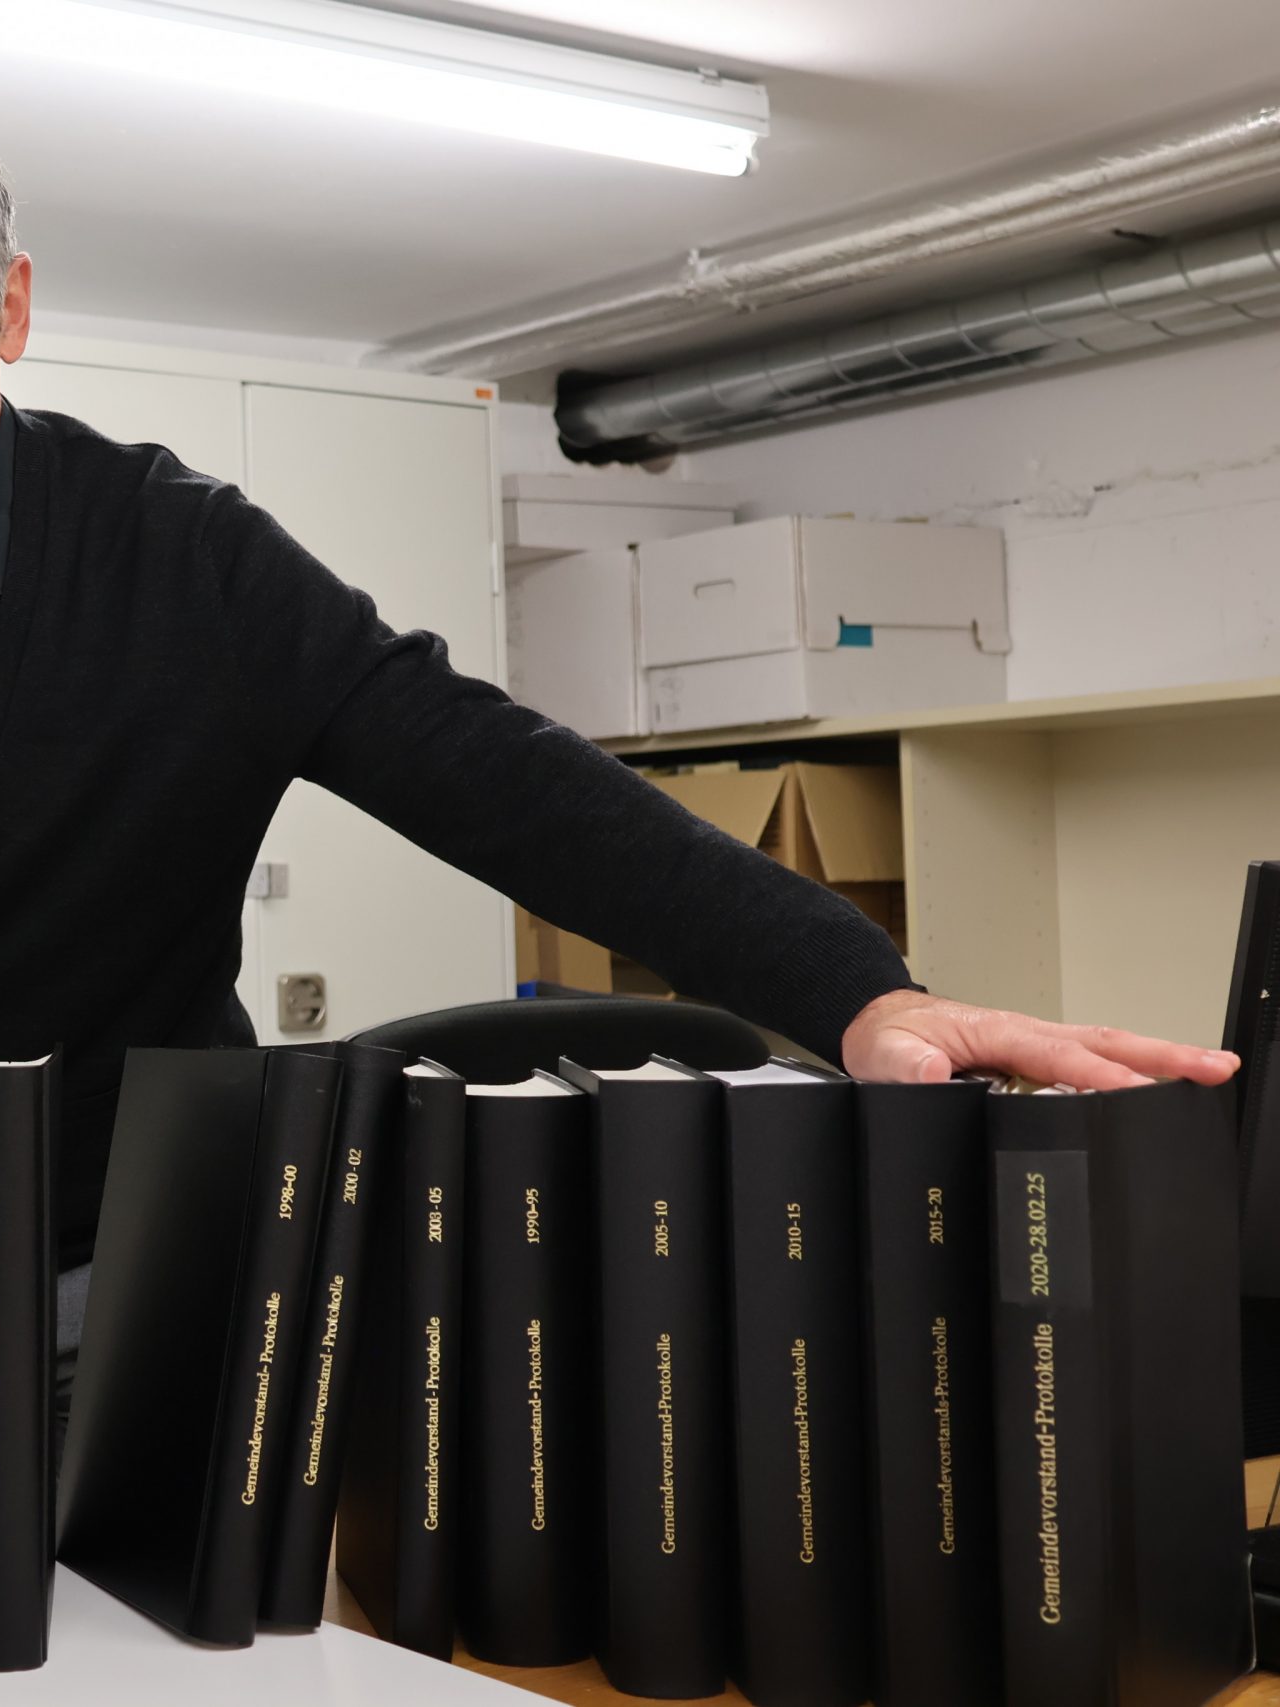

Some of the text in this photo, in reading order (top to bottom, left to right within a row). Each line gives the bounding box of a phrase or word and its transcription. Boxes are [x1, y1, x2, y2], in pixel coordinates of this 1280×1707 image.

[279, 1164, 298, 1220] 1998-00
[525, 1187, 540, 1243] 1990-95
[927, 1187, 954, 1554] Gemeindevorstands-Protokolle 2015-20
[654, 1199, 676, 1554] Gemeindevorstand-Protokolle 2005-10
[786, 1202, 815, 1564] Gemeindevorstand-Protokolle 2010-15
[1026, 1172, 1061, 1625] Gemeindevorstand-Protokolle 2020-28.02.25
